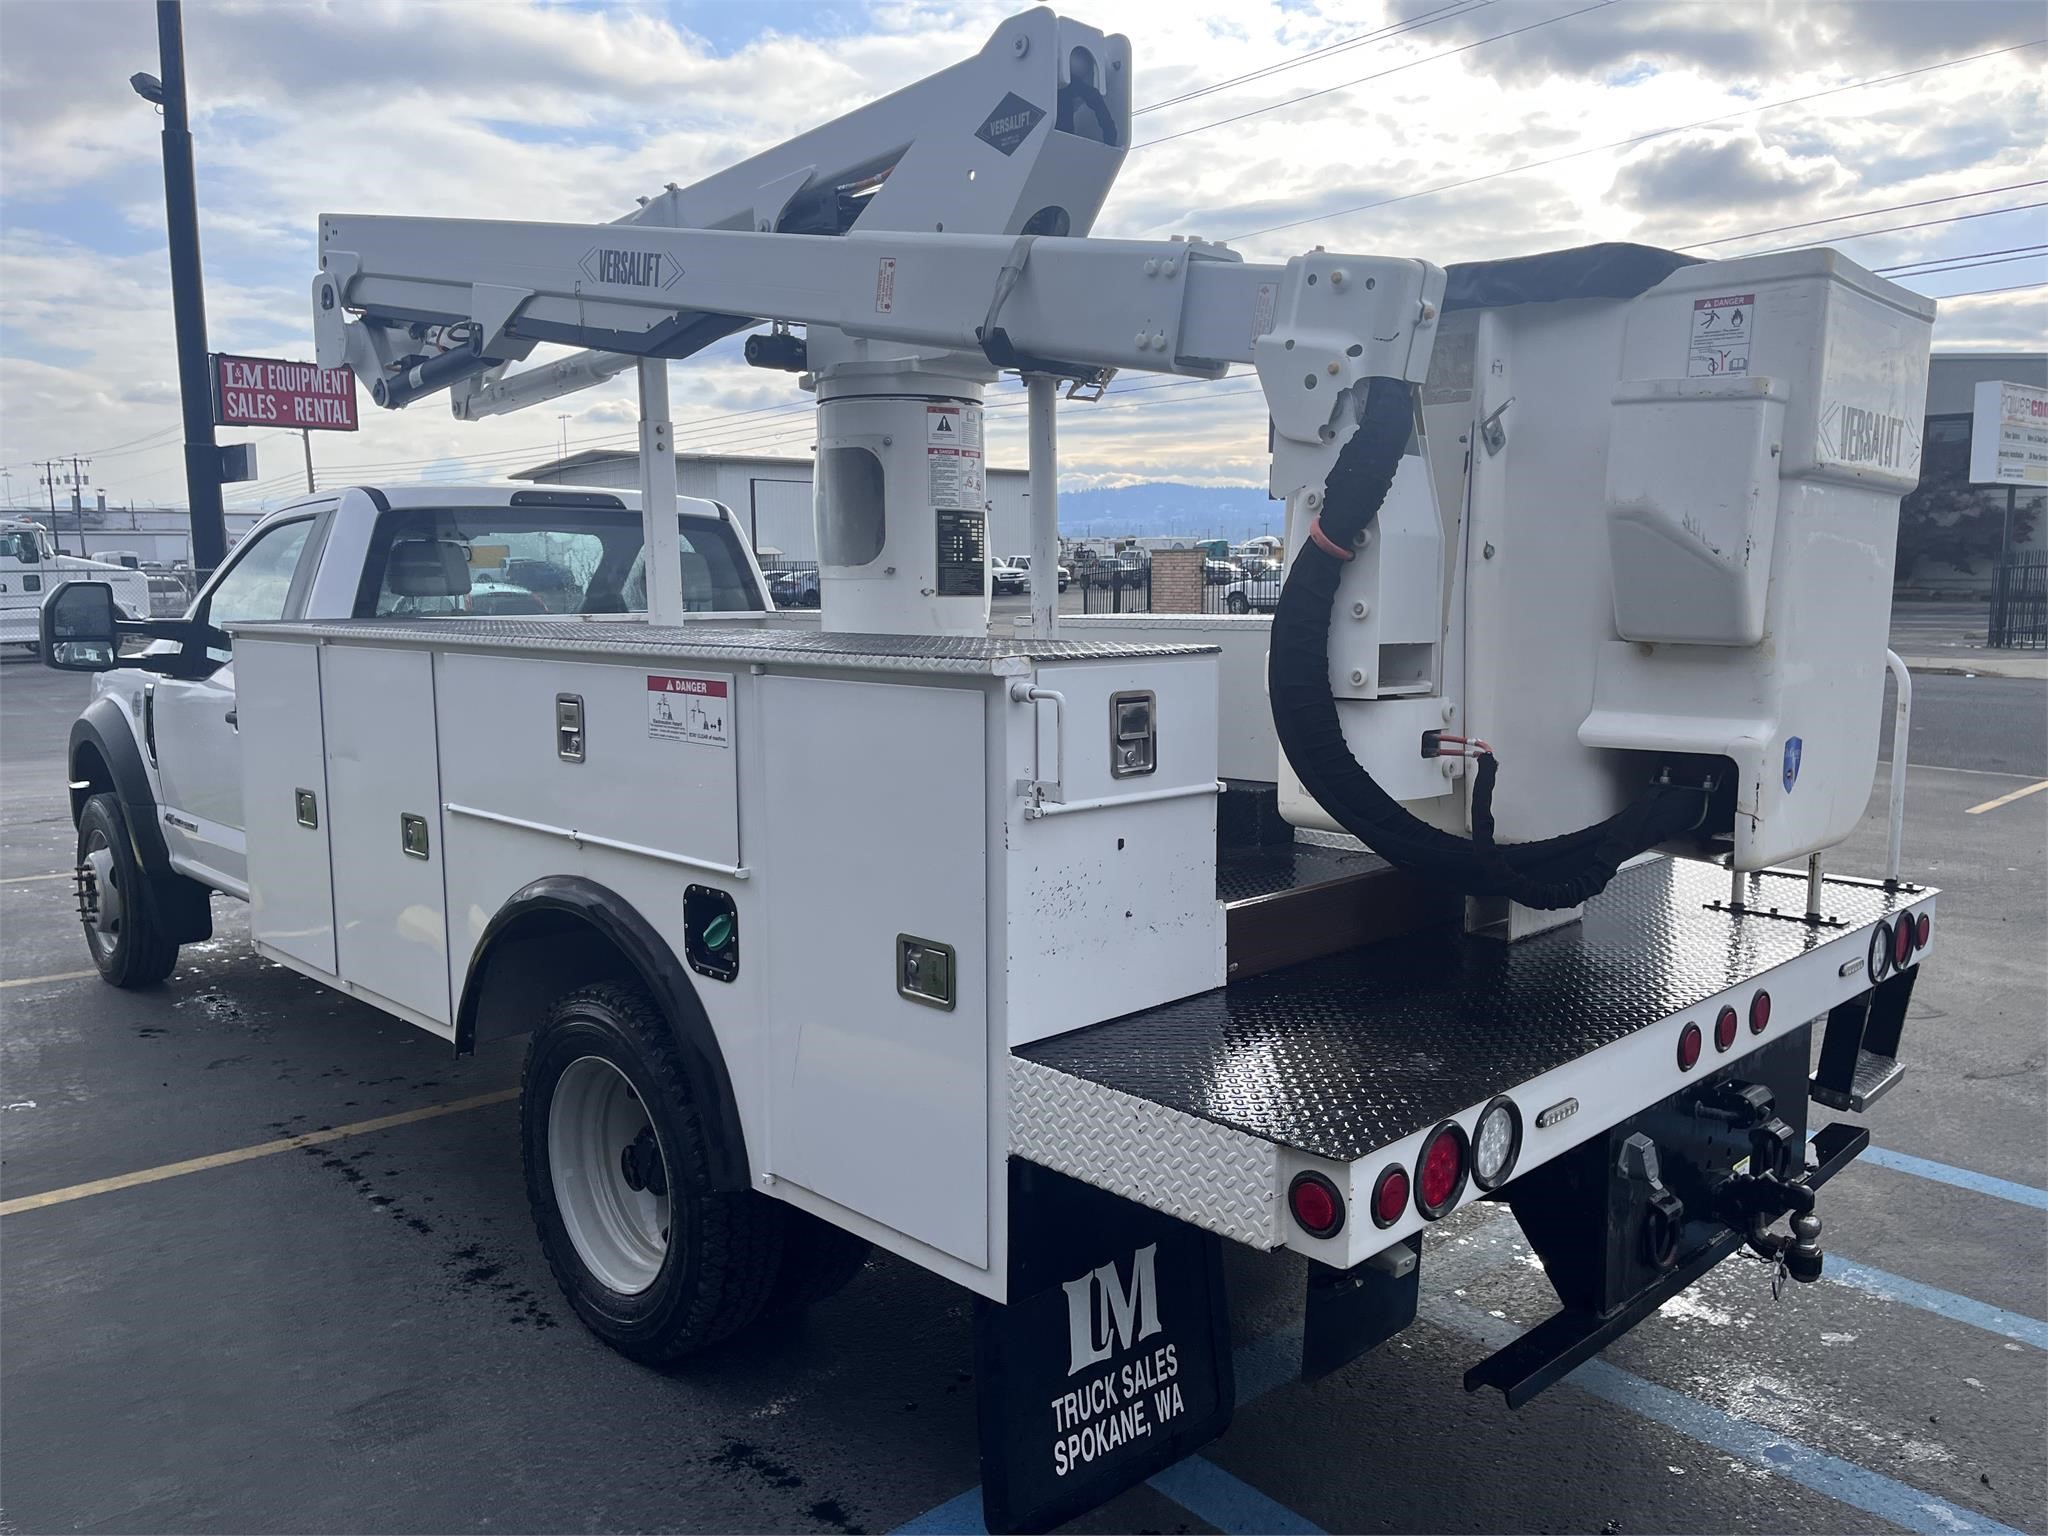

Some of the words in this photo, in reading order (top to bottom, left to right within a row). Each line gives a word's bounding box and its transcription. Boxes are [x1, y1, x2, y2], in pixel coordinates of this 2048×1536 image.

[990, 110, 1031, 137] VERSALIFT
[599, 249, 662, 288] VERSALIFT
[1713, 297, 1745, 307] DANGER
[223, 362, 264, 390] L&M
[267, 364, 349, 396] EQUIPMENT
[227, 391, 277, 420] SALES
[293, 396, 352, 425] RENTAL
[1840, 405, 1905, 468] VERSALIFT
[675, 680, 707, 694] DANGER
[1062, 1242, 1163, 1377] LM
[1051, 1372, 1119, 1433] TRUCK
[1121, 1343, 1178, 1399] SALES
[1054, 1400, 1152, 1477] SPOKANE,
[1154, 1382, 1185, 1424] WA
